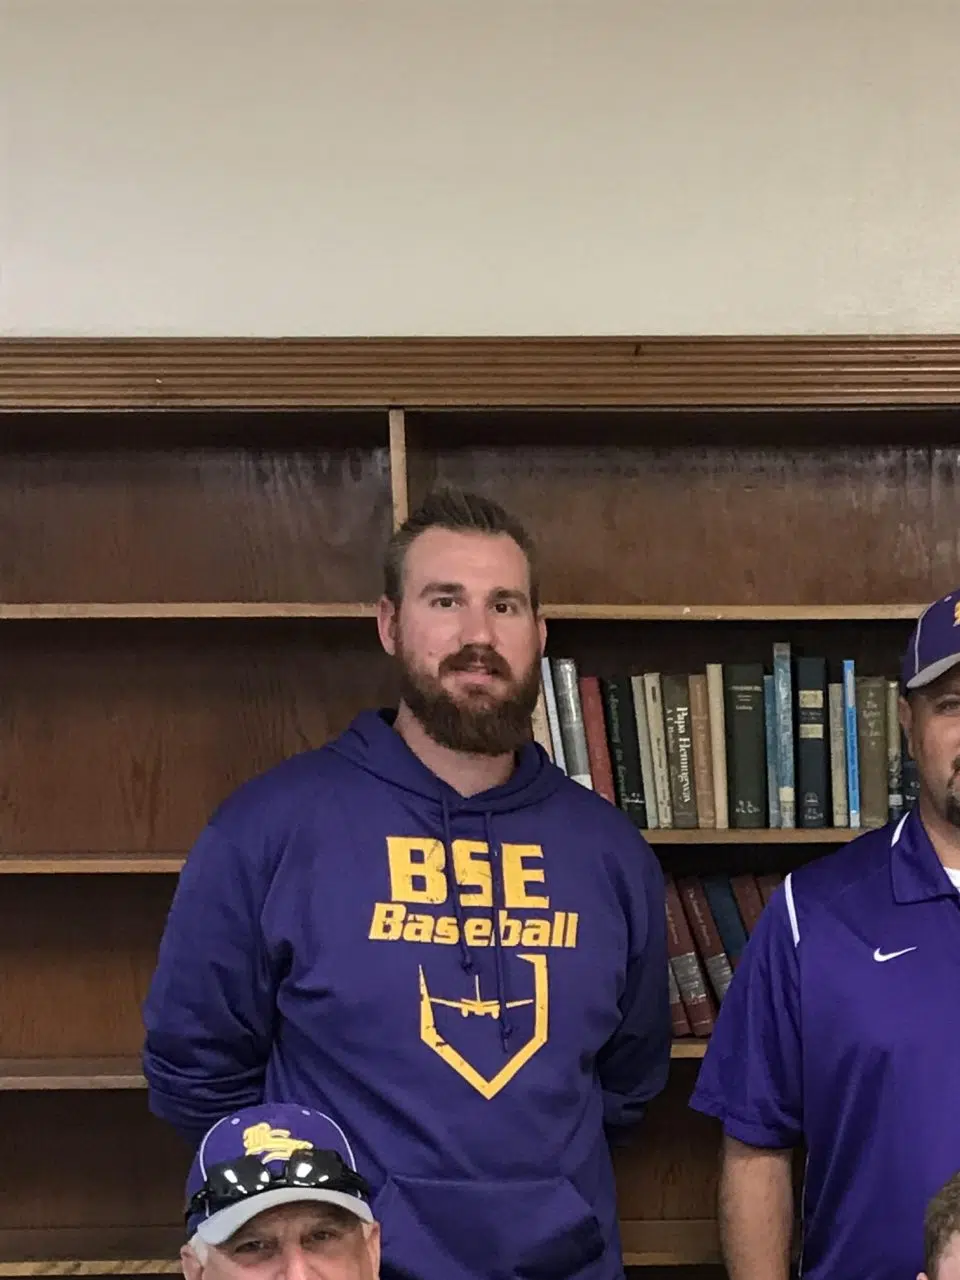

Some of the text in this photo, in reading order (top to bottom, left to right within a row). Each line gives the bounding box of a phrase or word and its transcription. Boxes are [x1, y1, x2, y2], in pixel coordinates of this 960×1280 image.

[673, 706, 689, 734] Papa
[677, 737, 692, 803] Hemingway
[386, 836, 550, 909] BSE
[368, 902, 579, 948] Baseball
